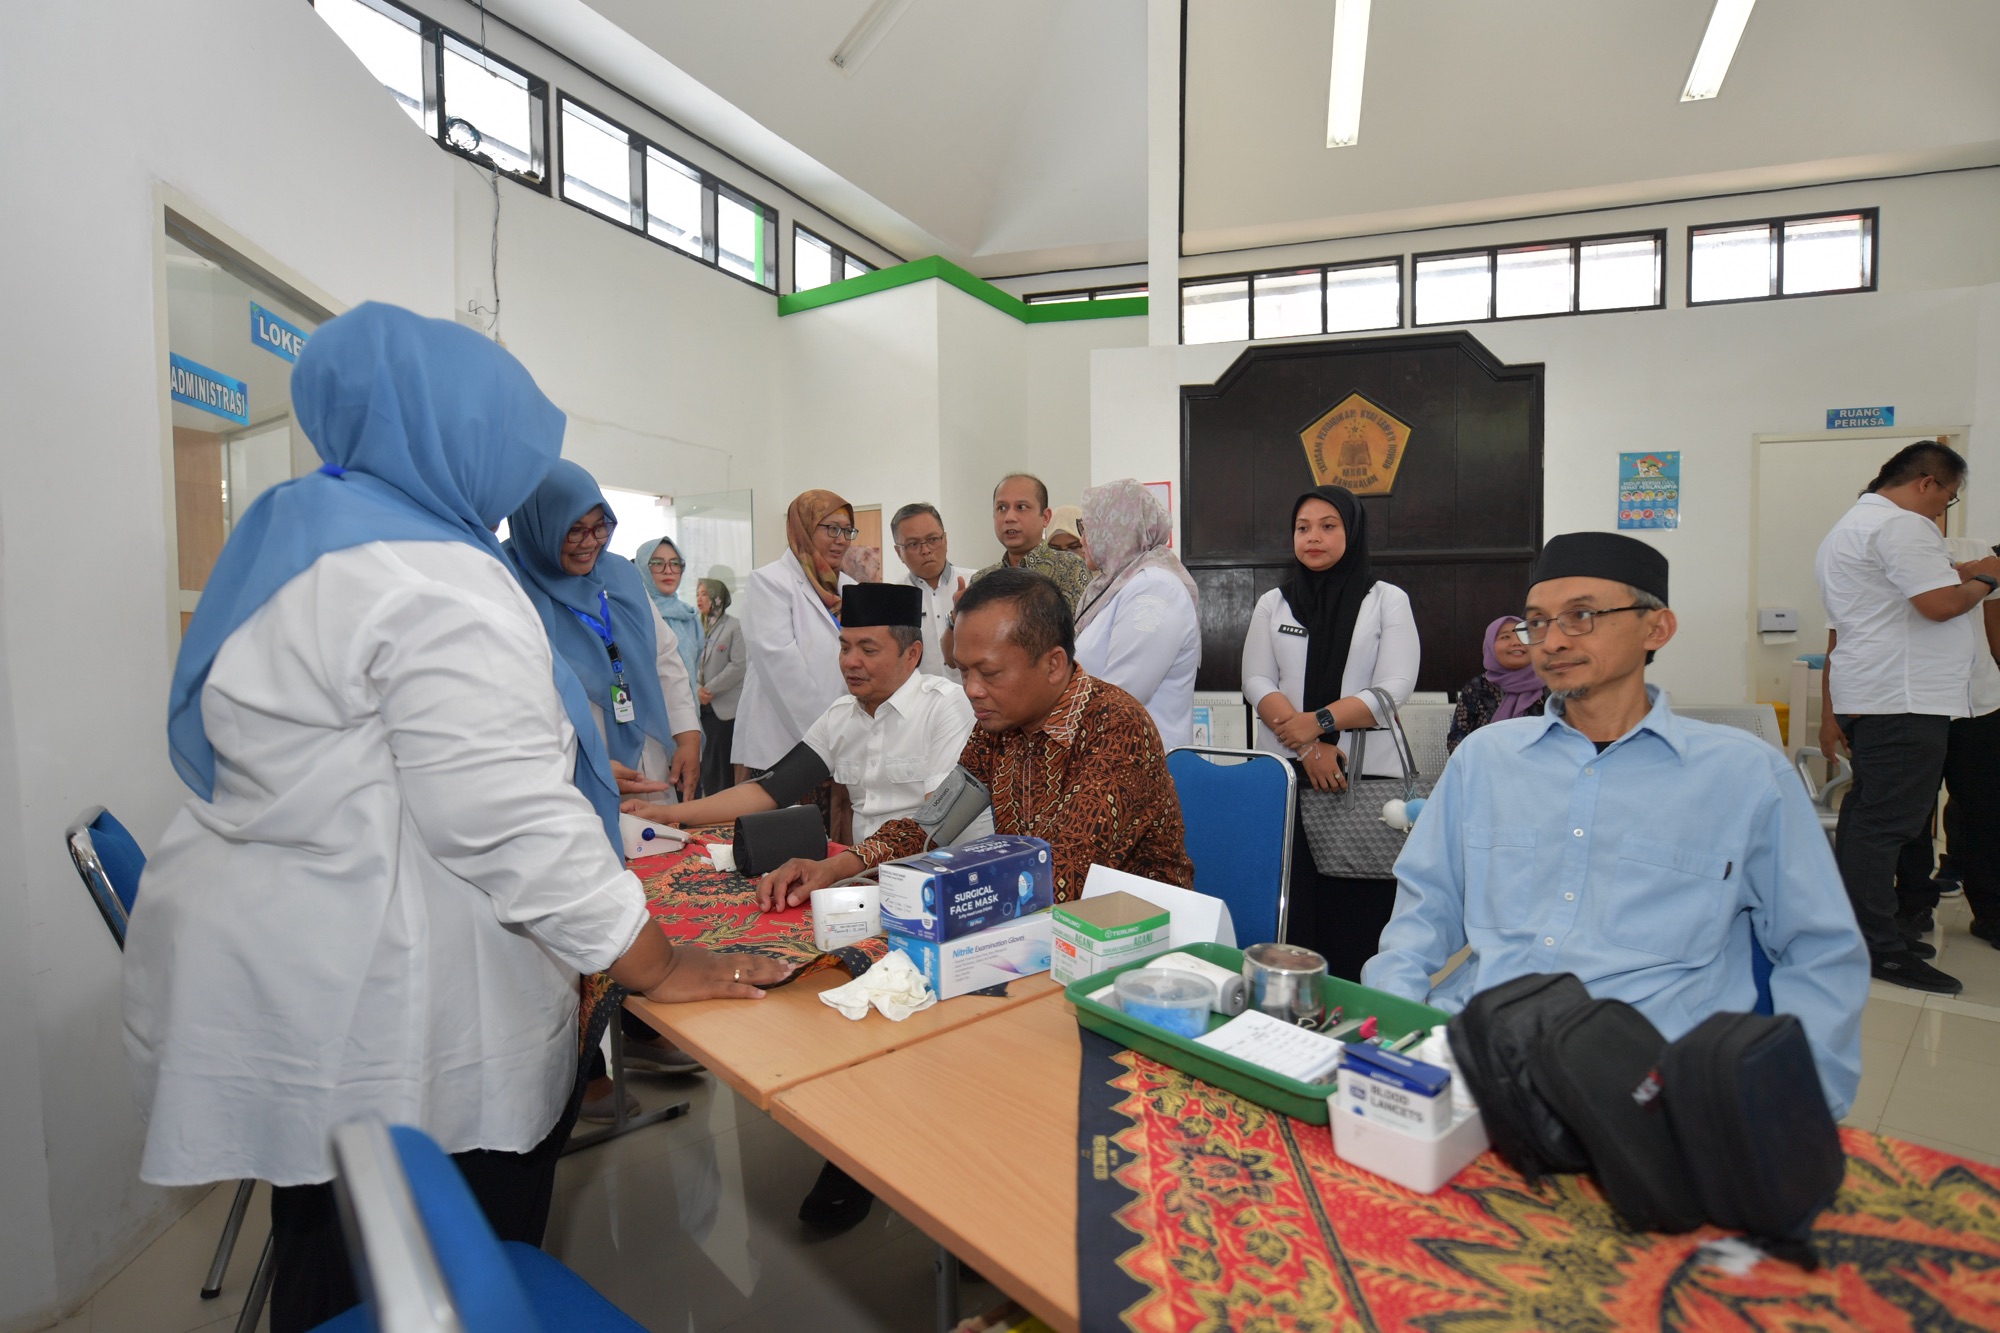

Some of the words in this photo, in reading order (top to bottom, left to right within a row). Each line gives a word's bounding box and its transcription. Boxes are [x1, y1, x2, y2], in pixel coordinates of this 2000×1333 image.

[171, 366, 246, 418] ADMINISTRASI
[1839, 408, 1881, 418] RUANG
[1834, 417, 1885, 428] PERIKSA
[1332, 474, 1378, 489] BANGKALAN
[1282, 626, 1303, 635] SISKA
[932, 788, 950, 807] omron
[954, 885, 994, 903] SURGICAL
[950, 900, 973, 916] FACE
[975, 893, 999, 909] MASK
[1059, 914, 1081, 929] TERUMO
[1112, 926, 1139, 937] TERUMO
[1134, 932, 1153, 946] AGANI
[952, 946, 974, 958] Nitrile
[974, 939, 1008, 953] Examination
[1008, 935, 1025, 944] Gloves
[1075, 933, 1093, 950] AGANI
[1370, 1085, 1410, 1105] BLOOD
[1370, 1097, 1424, 1123] LANCETS
